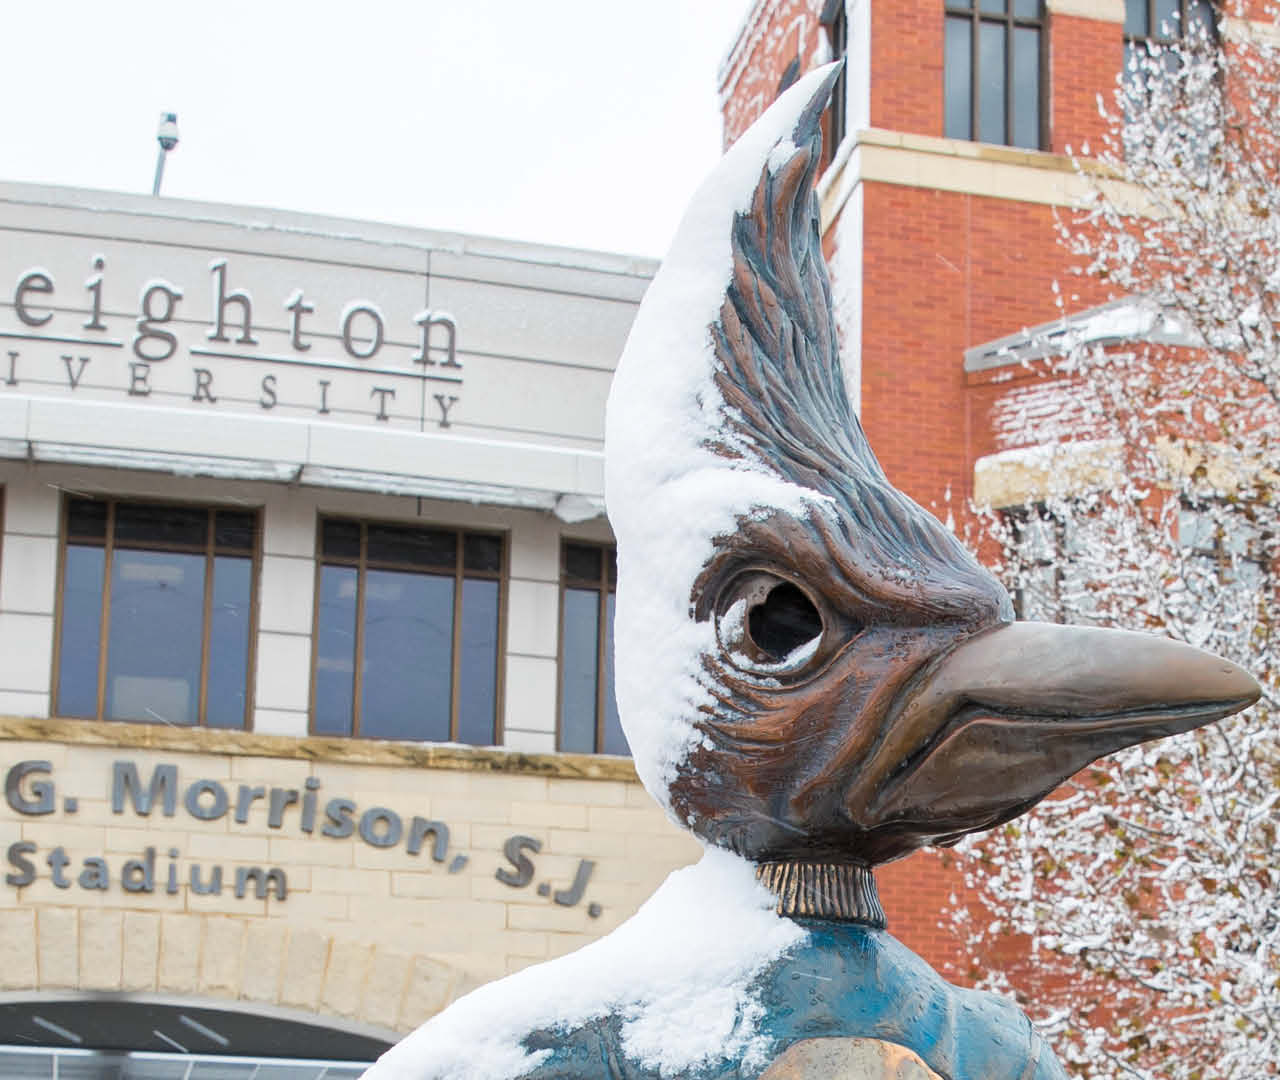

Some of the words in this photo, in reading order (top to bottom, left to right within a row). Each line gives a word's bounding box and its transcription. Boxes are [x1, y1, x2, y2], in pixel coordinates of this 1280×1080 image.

[5, 760, 78, 815] G.
[112, 760, 469, 874] Morrison,
[495, 834, 603, 919] S.J.
[6, 840, 288, 901] Stadium
